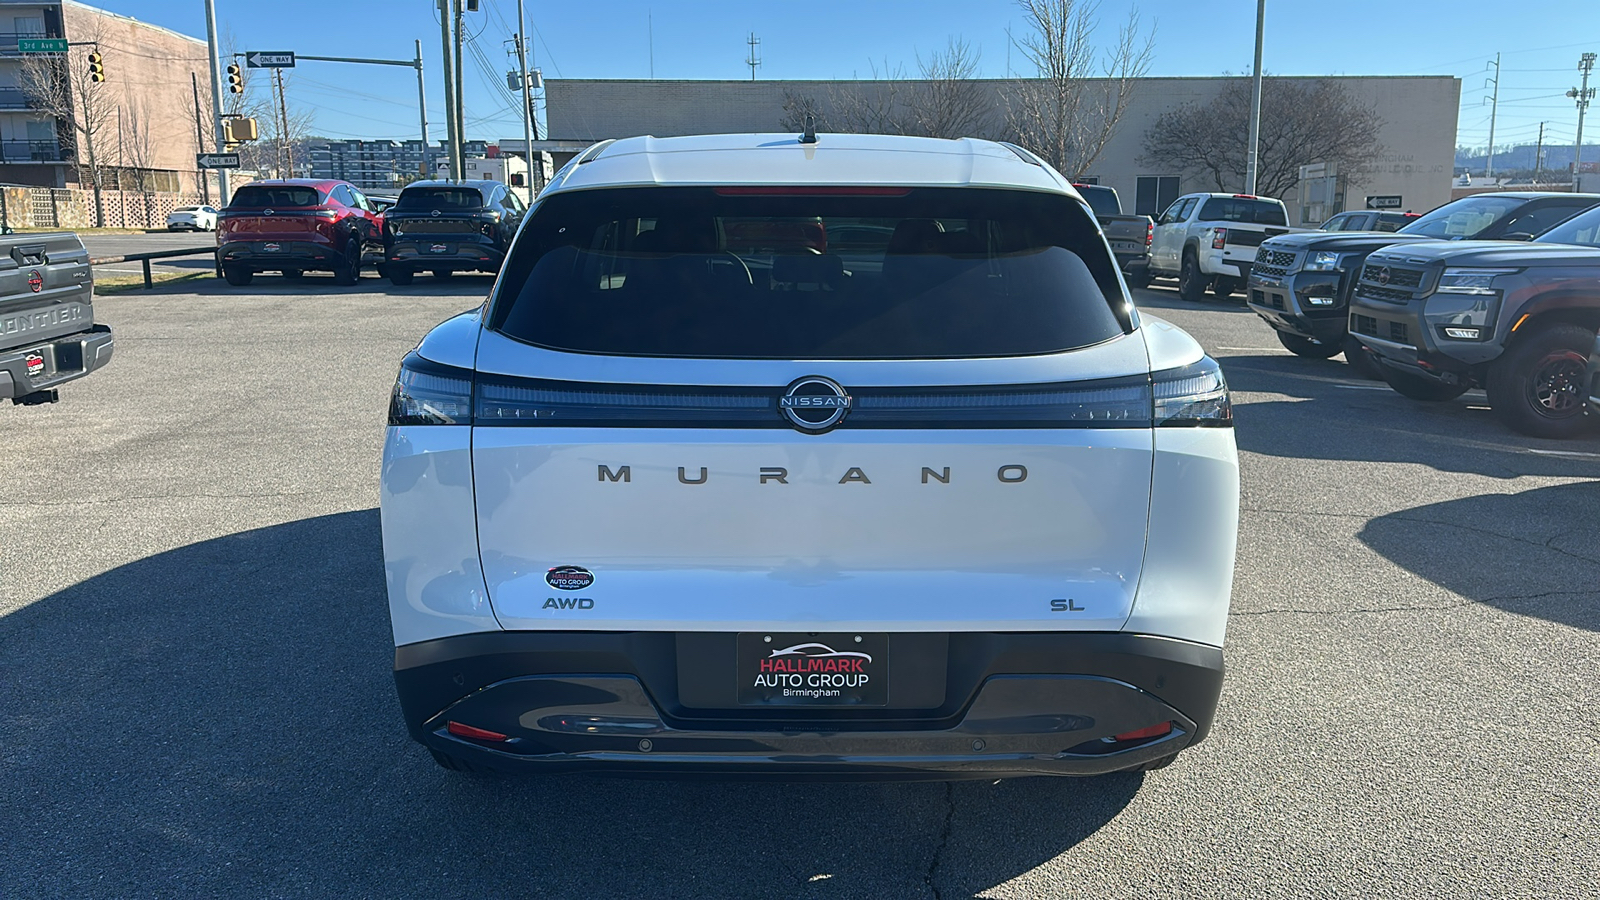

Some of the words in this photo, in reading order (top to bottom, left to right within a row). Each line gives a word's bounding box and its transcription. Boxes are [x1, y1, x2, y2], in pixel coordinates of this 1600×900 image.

[23, 42, 36, 50] 3rd
[781, 397, 848, 406] NISSAN
[597, 464, 1029, 485] MURANO
[542, 598, 595, 609] AWD
[1050, 598, 1085, 611] SL
[760, 658, 864, 672] HALLMARK
[754, 673, 803, 687] AUTO
[807, 673, 870, 687] GROUP
[783, 688, 840, 698] Birmingham
